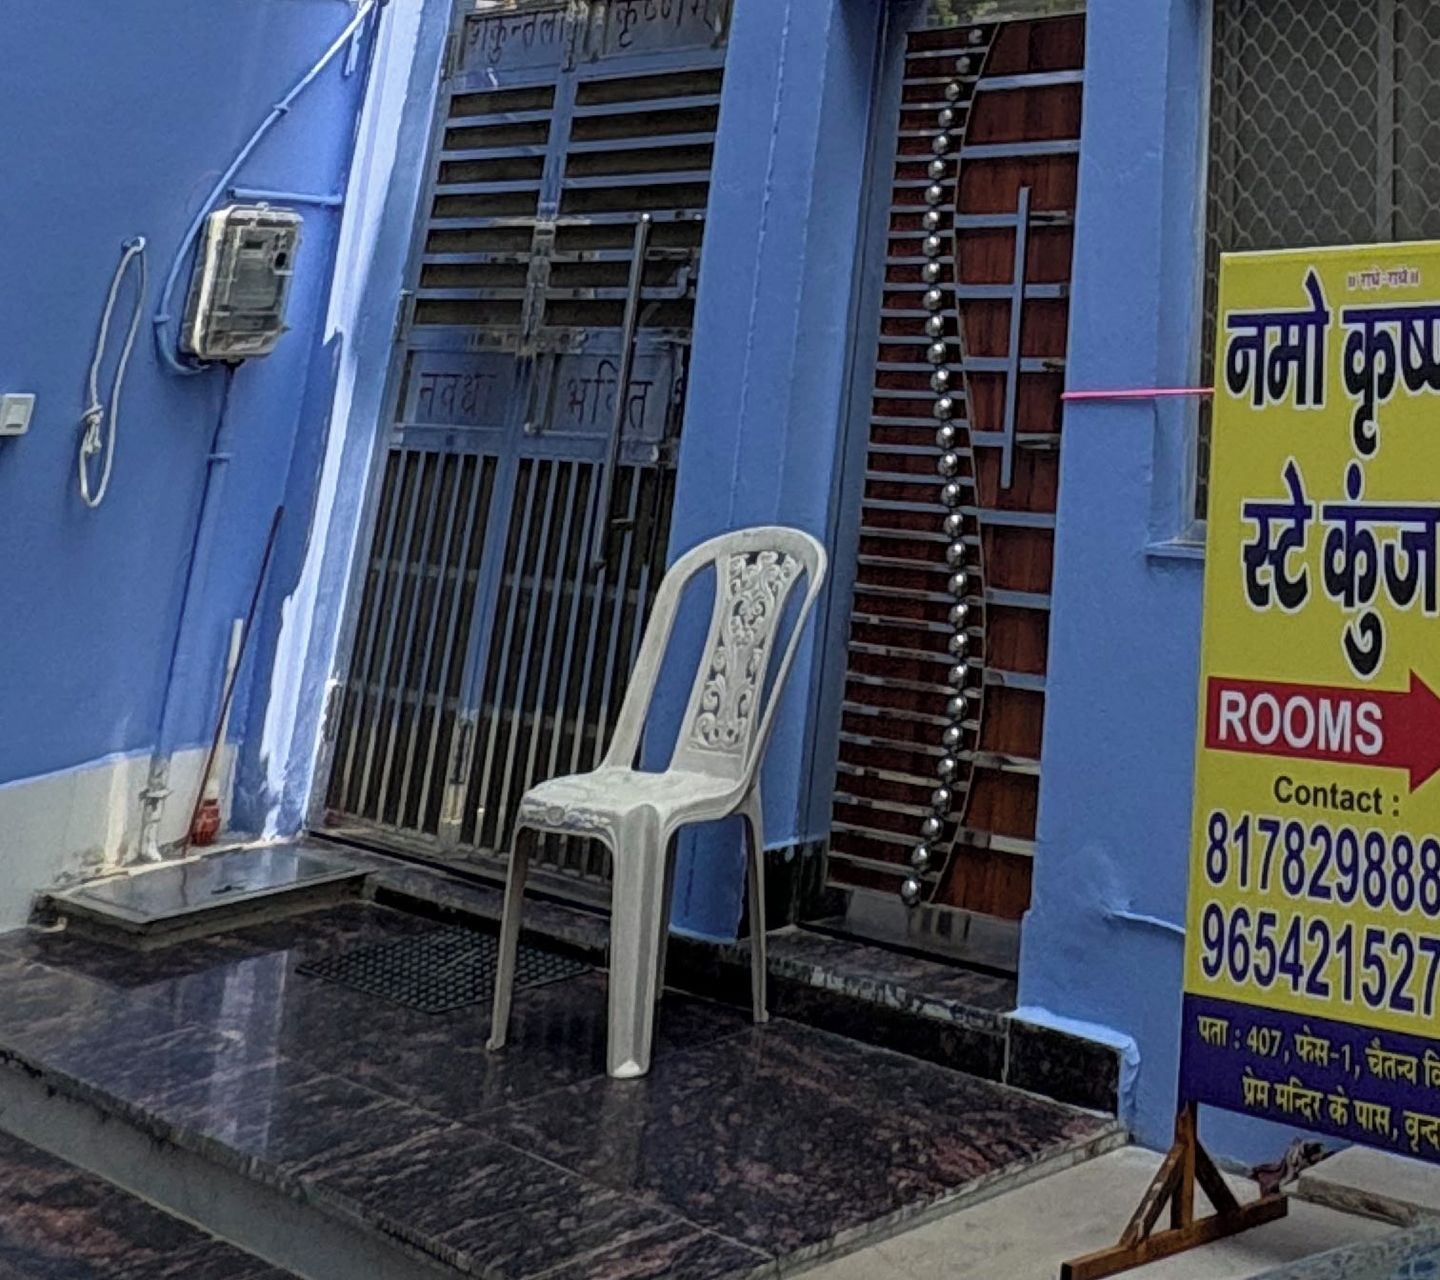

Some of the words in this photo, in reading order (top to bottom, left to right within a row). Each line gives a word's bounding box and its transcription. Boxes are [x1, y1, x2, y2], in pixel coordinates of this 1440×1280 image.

[1226, 269, 1329, 406] नमो
[1243, 460, 1313, 610] स्टे
[1218, 690, 1384, 755] ROOMS
[1273, 775, 1383, 814] Contact
[1198, 1015, 1228, 1047] पता
[1242, 1066, 1270, 1108] प्रेम
[1273, 1077, 1324, 1123] मन्दिर
[1328, 1085, 1348, 1126] के
